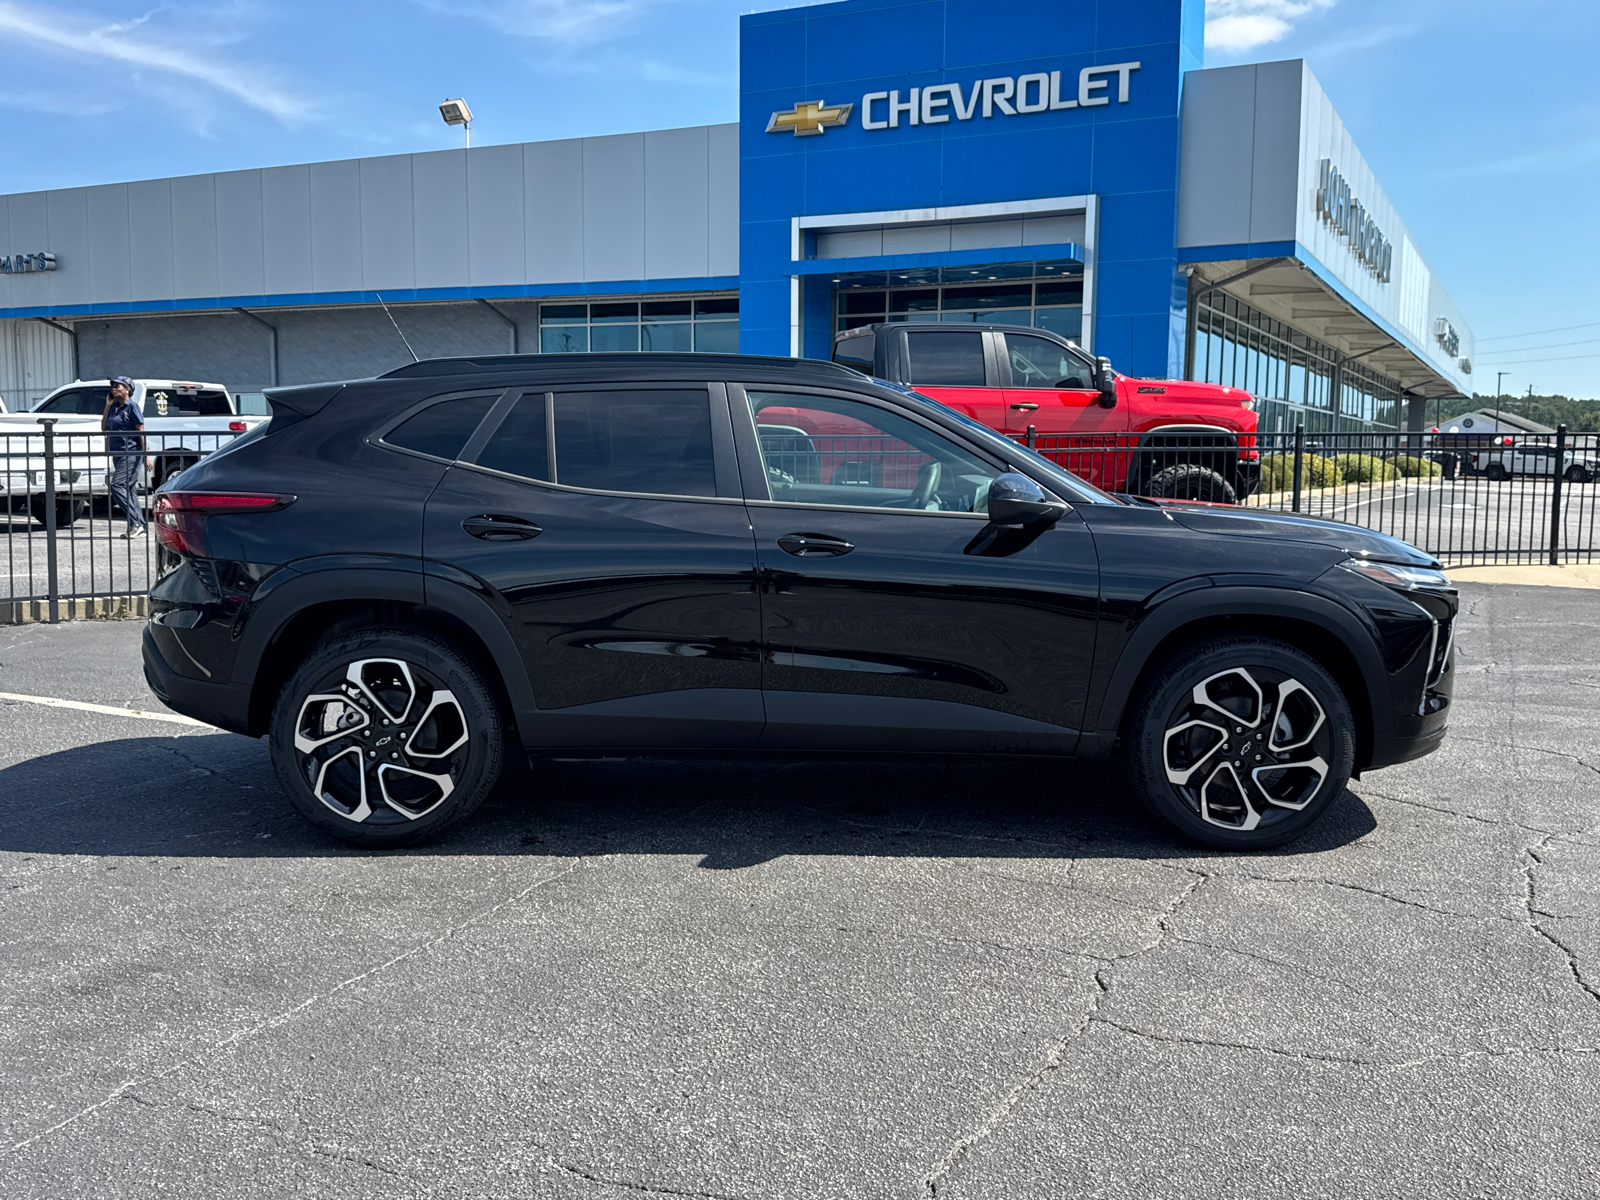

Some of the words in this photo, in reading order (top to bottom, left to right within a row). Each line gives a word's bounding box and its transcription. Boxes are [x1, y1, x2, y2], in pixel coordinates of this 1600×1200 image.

[862, 61, 1141, 130] CHEVROLET
[0, 252, 50, 273] ARTS
[449, 669, 482, 713] Continental
[1145, 736, 1159, 784] Continental
